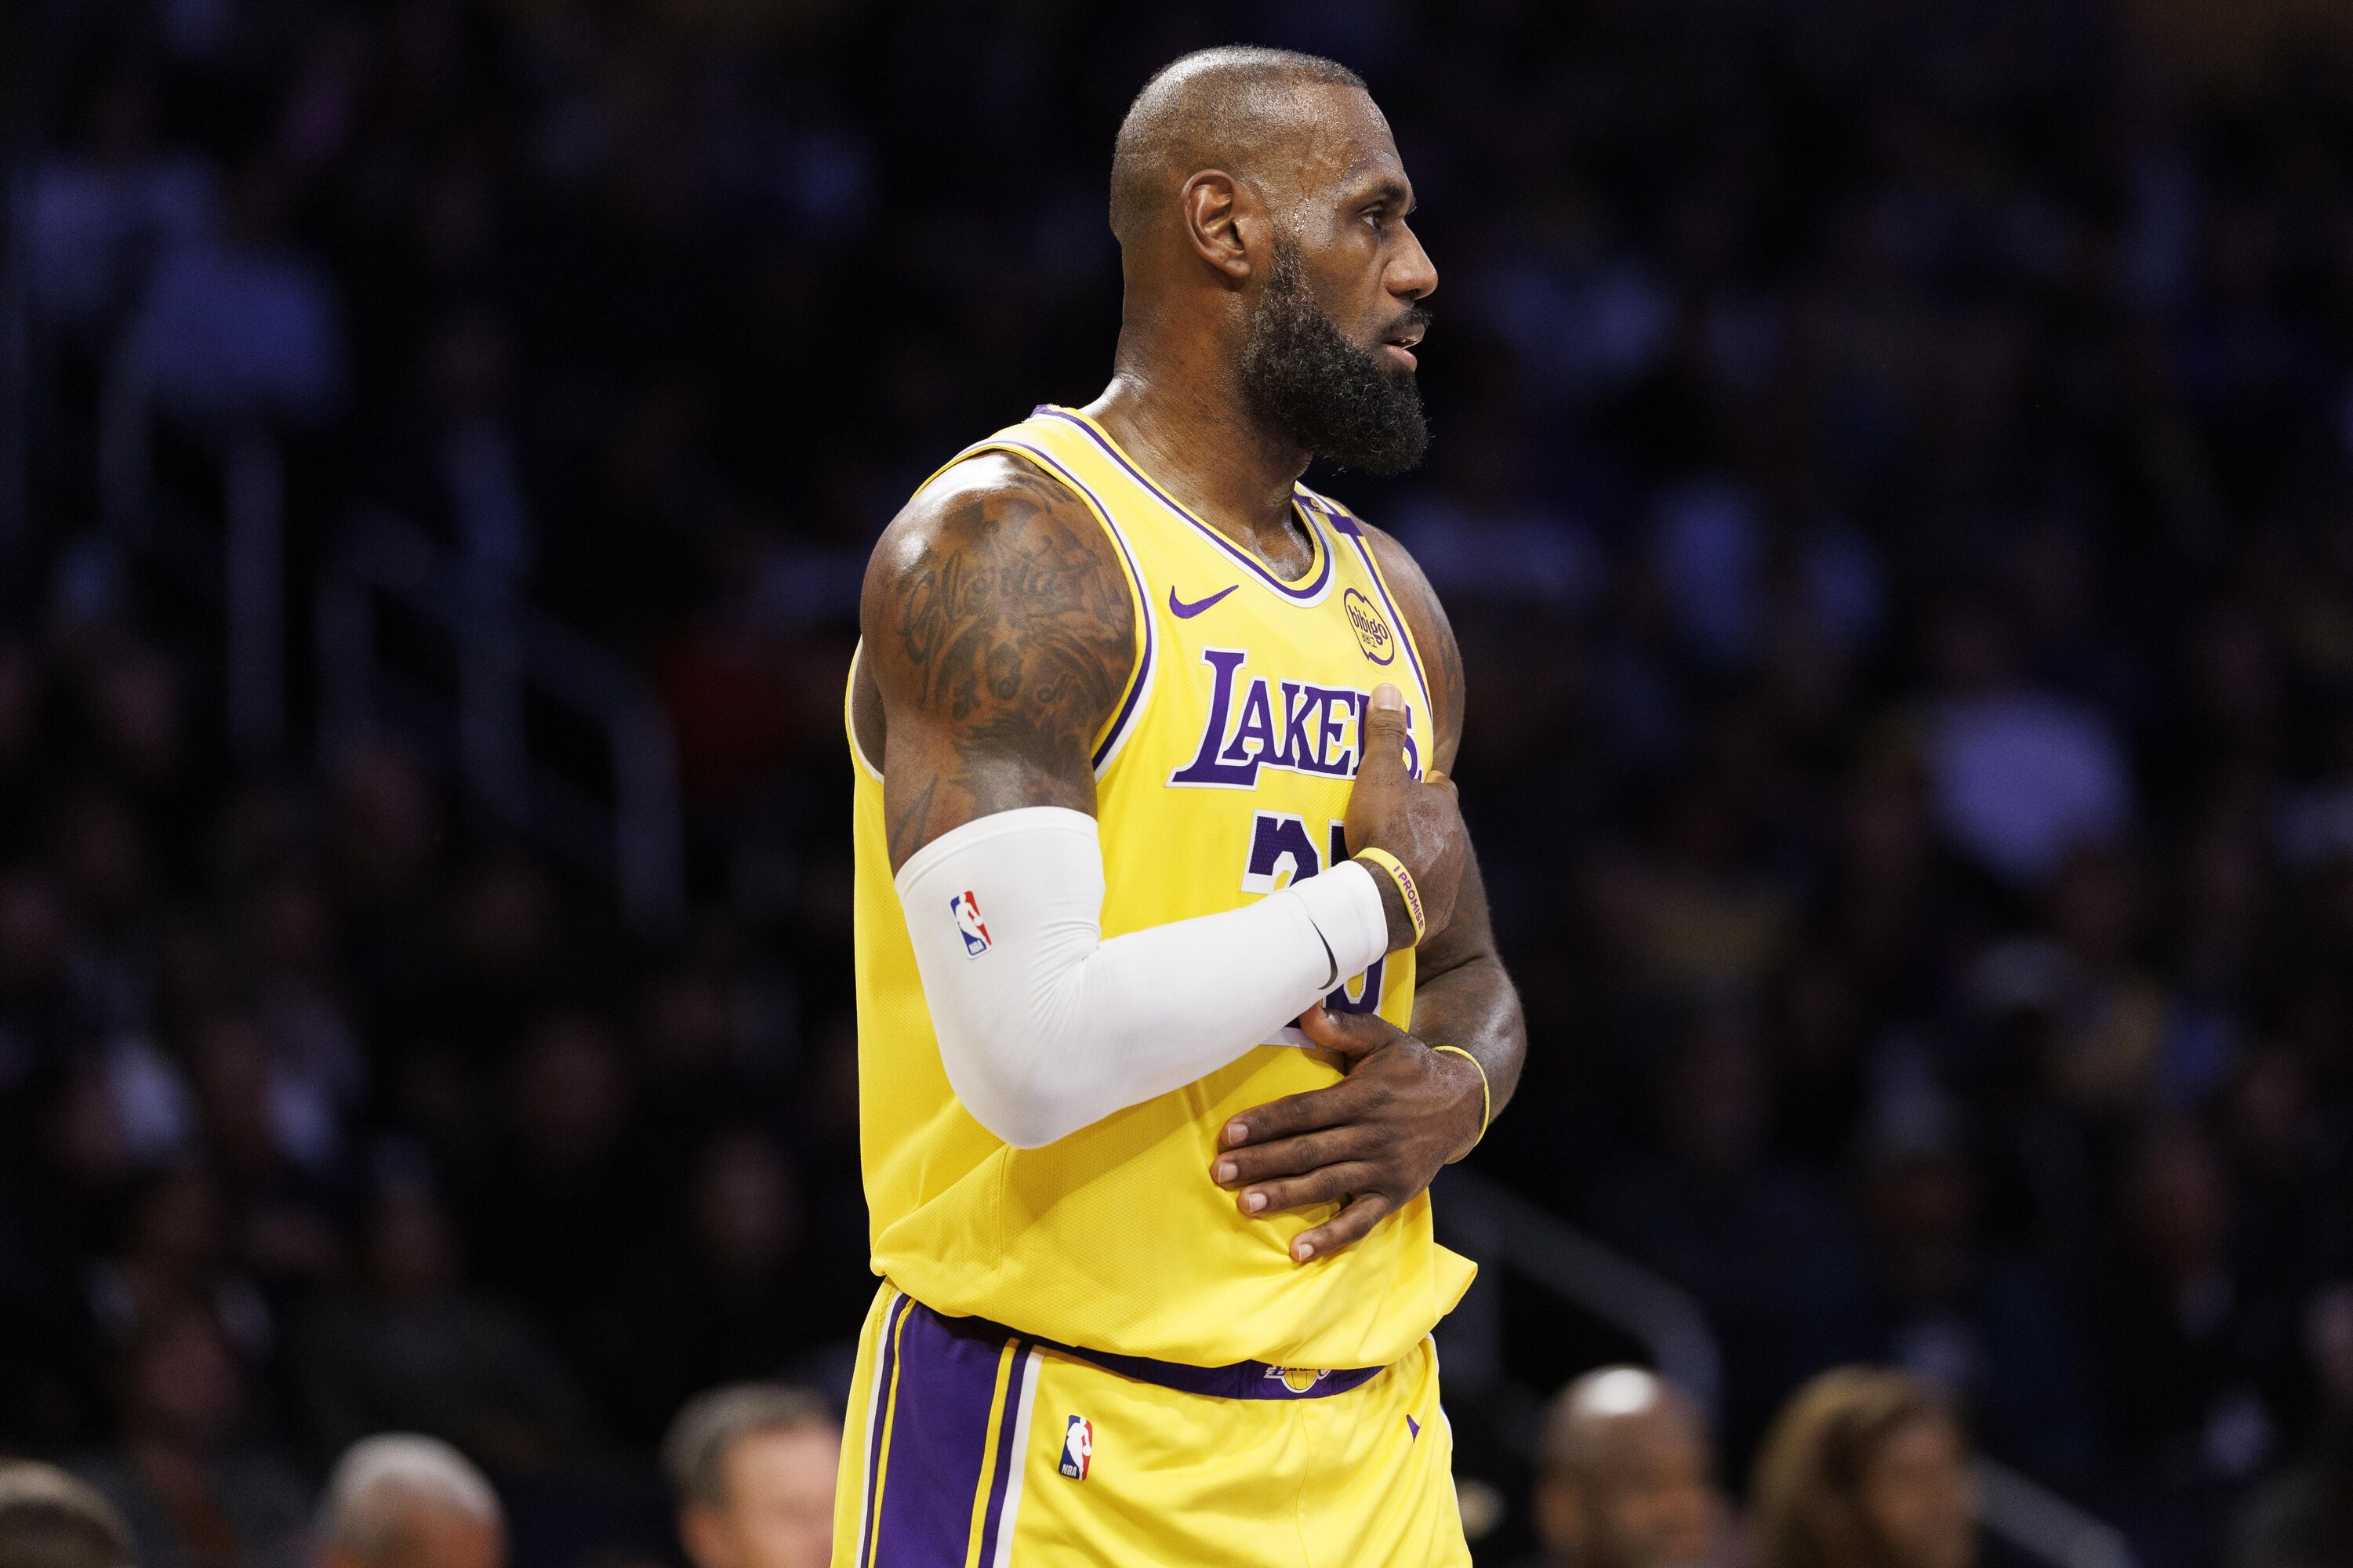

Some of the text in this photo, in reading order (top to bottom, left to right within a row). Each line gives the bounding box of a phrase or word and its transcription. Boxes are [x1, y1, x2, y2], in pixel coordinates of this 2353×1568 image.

[1348, 604, 1389, 646] bibigo
[1398, 872, 1424, 930] PROMISE
[1061, 1463, 1077, 1478] NBA
